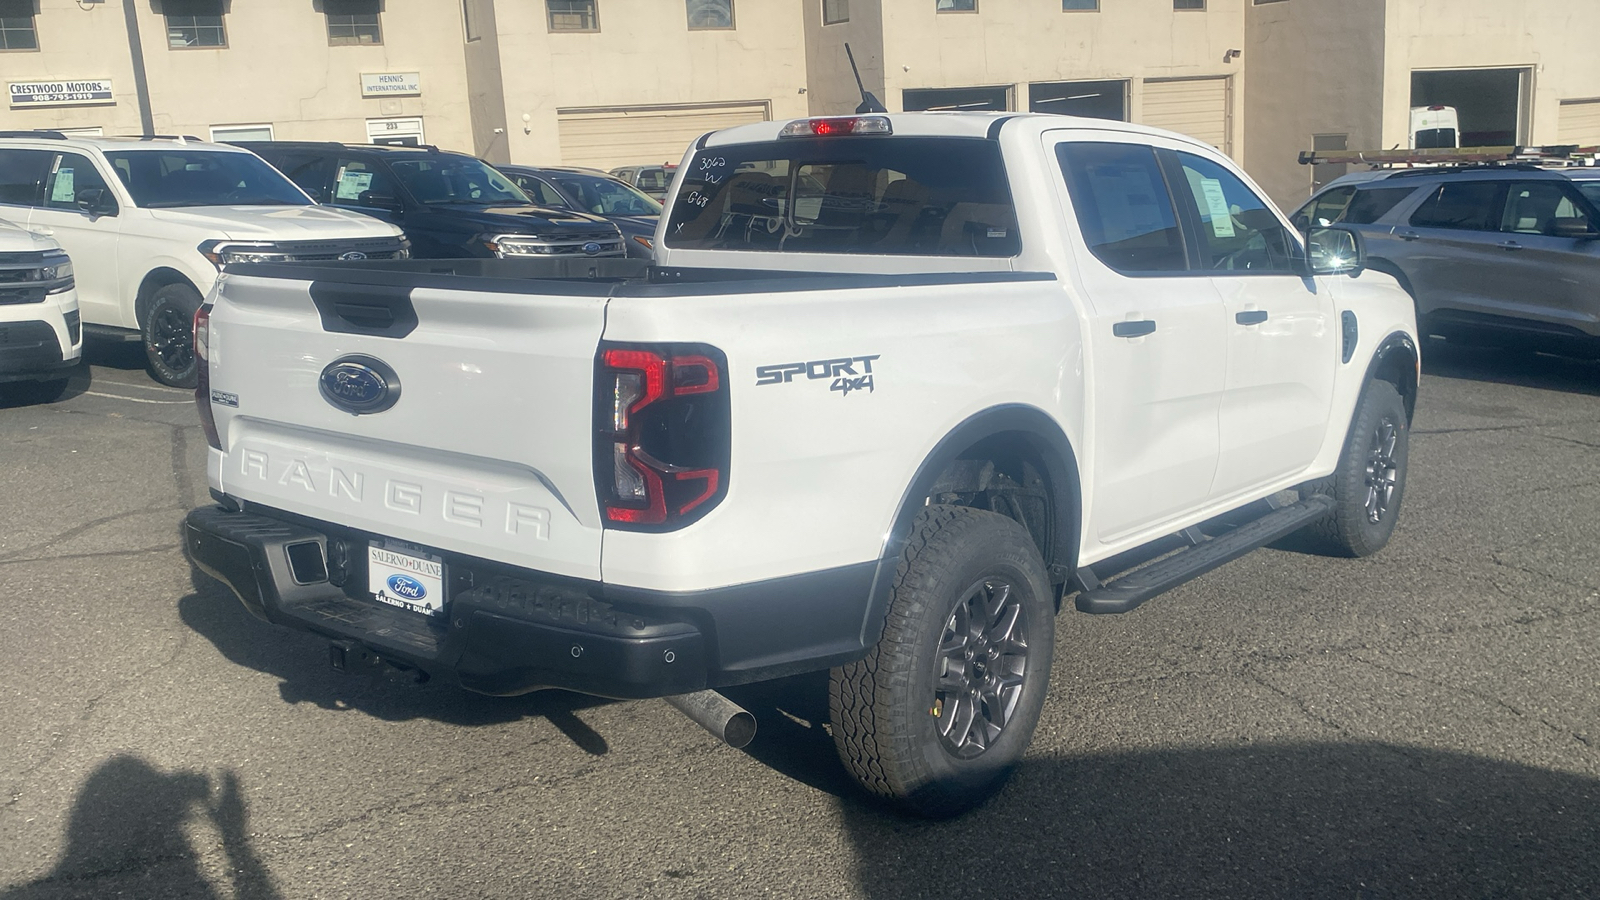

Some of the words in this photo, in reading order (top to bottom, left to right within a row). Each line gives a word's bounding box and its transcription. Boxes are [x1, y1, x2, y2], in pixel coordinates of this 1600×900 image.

[10, 84, 63, 94] CRESTWOOD
[66, 82, 102, 92] MOTORS
[379, 75, 403, 83] HENNIS
[32, 93, 93, 101] 908-795-1919
[386, 122, 398, 130] 233
[755, 354, 881, 386] SPORT
[333, 371, 368, 398] Ford
[241, 448, 551, 540] RANGER
[372, 550, 408, 567] SALERNO
[412, 560, 441, 576] DUANE
[395, 578, 418, 597] Ford
